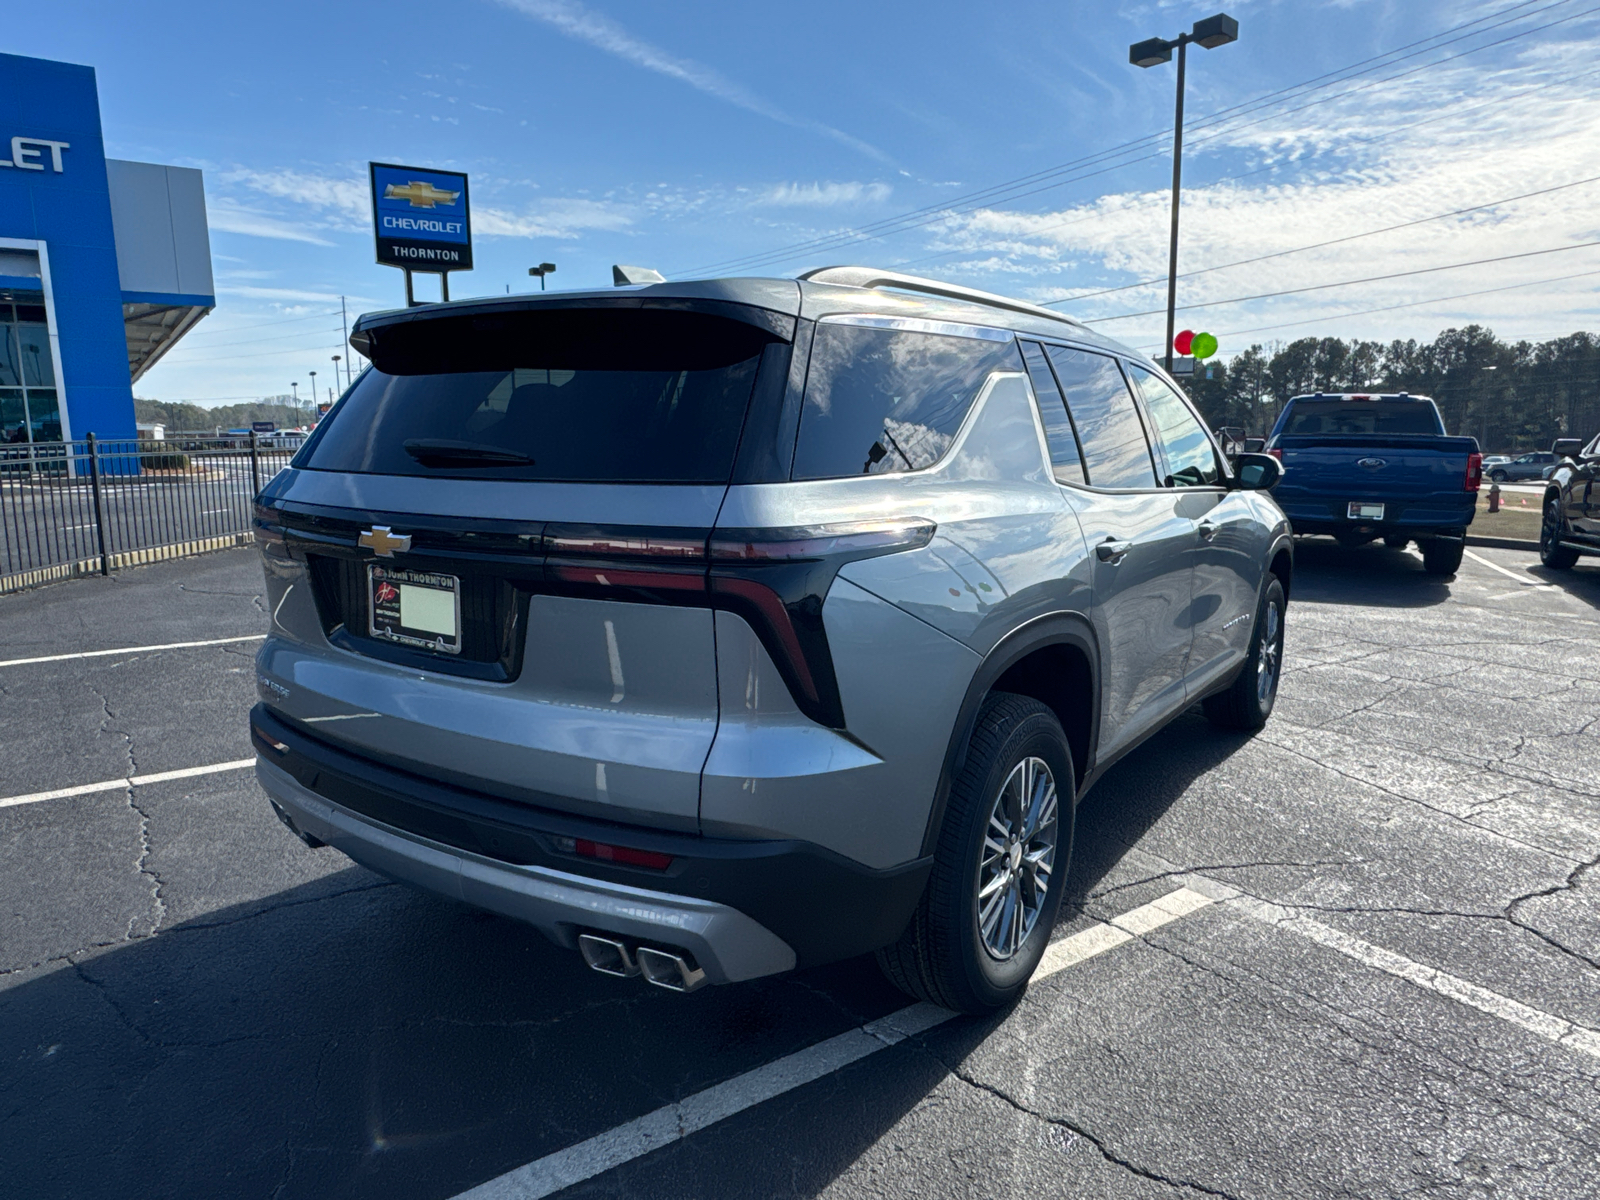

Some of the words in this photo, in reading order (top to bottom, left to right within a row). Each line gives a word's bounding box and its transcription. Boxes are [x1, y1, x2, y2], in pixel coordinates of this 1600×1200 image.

[383, 216, 462, 234] CHEVROLET
[392, 246, 459, 261] THORNTON
[387, 569, 409, 581] JOHN
[409, 572, 454, 588] THORNTON
